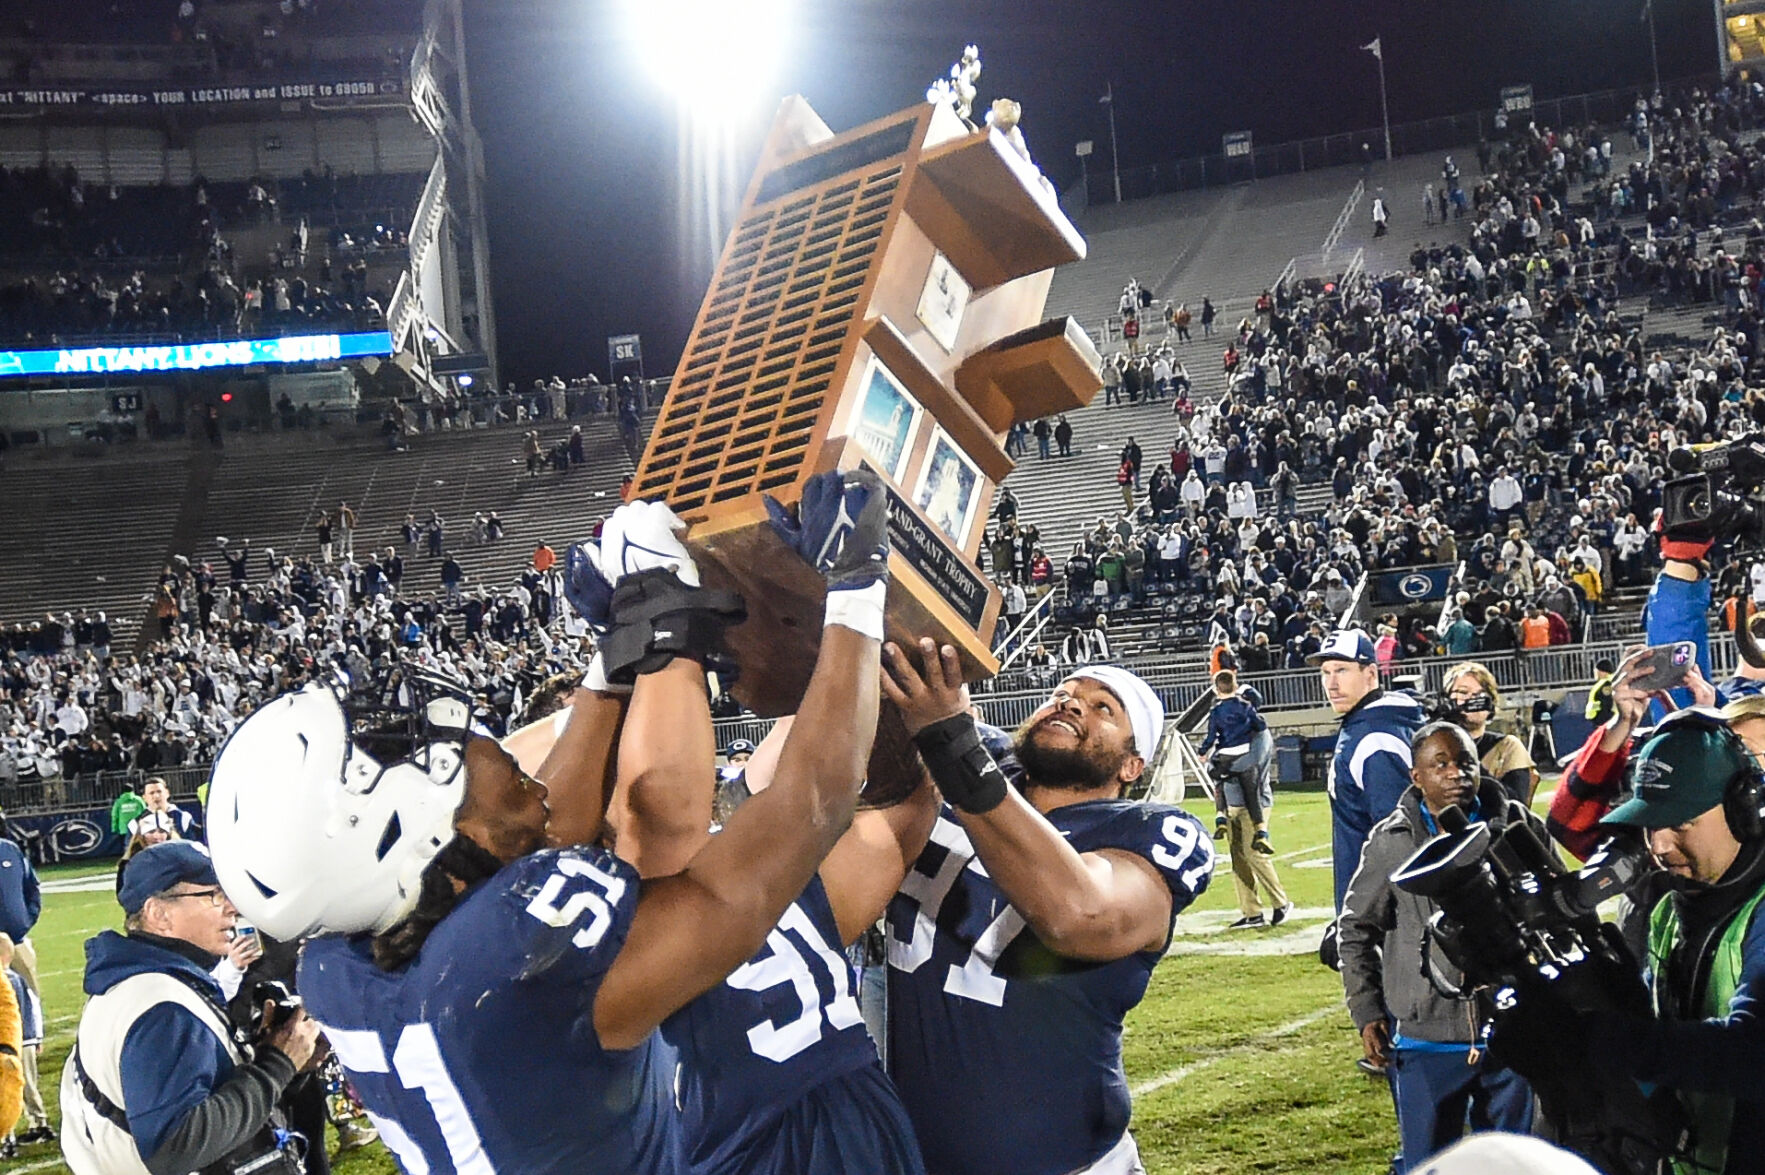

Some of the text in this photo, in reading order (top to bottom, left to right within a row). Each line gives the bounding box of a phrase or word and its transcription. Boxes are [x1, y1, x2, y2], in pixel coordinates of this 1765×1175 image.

[153, 91, 185, 104] YOUR
[192, 88, 250, 102] LOCATION
[255, 87, 276, 99] and
[280, 84, 315, 98] ISSUE
[320, 85, 332, 96] to
[177, 341, 253, 369] LIONS
[616, 343, 634, 359] SK
[118, 396, 137, 409] SJ
[886, 498, 944, 564] LAND-GRANT
[944, 558, 978, 599] TROPHY
[1151, 814, 1216, 893] 97
[525, 857, 627, 949] 51
[726, 901, 866, 1063] 91
